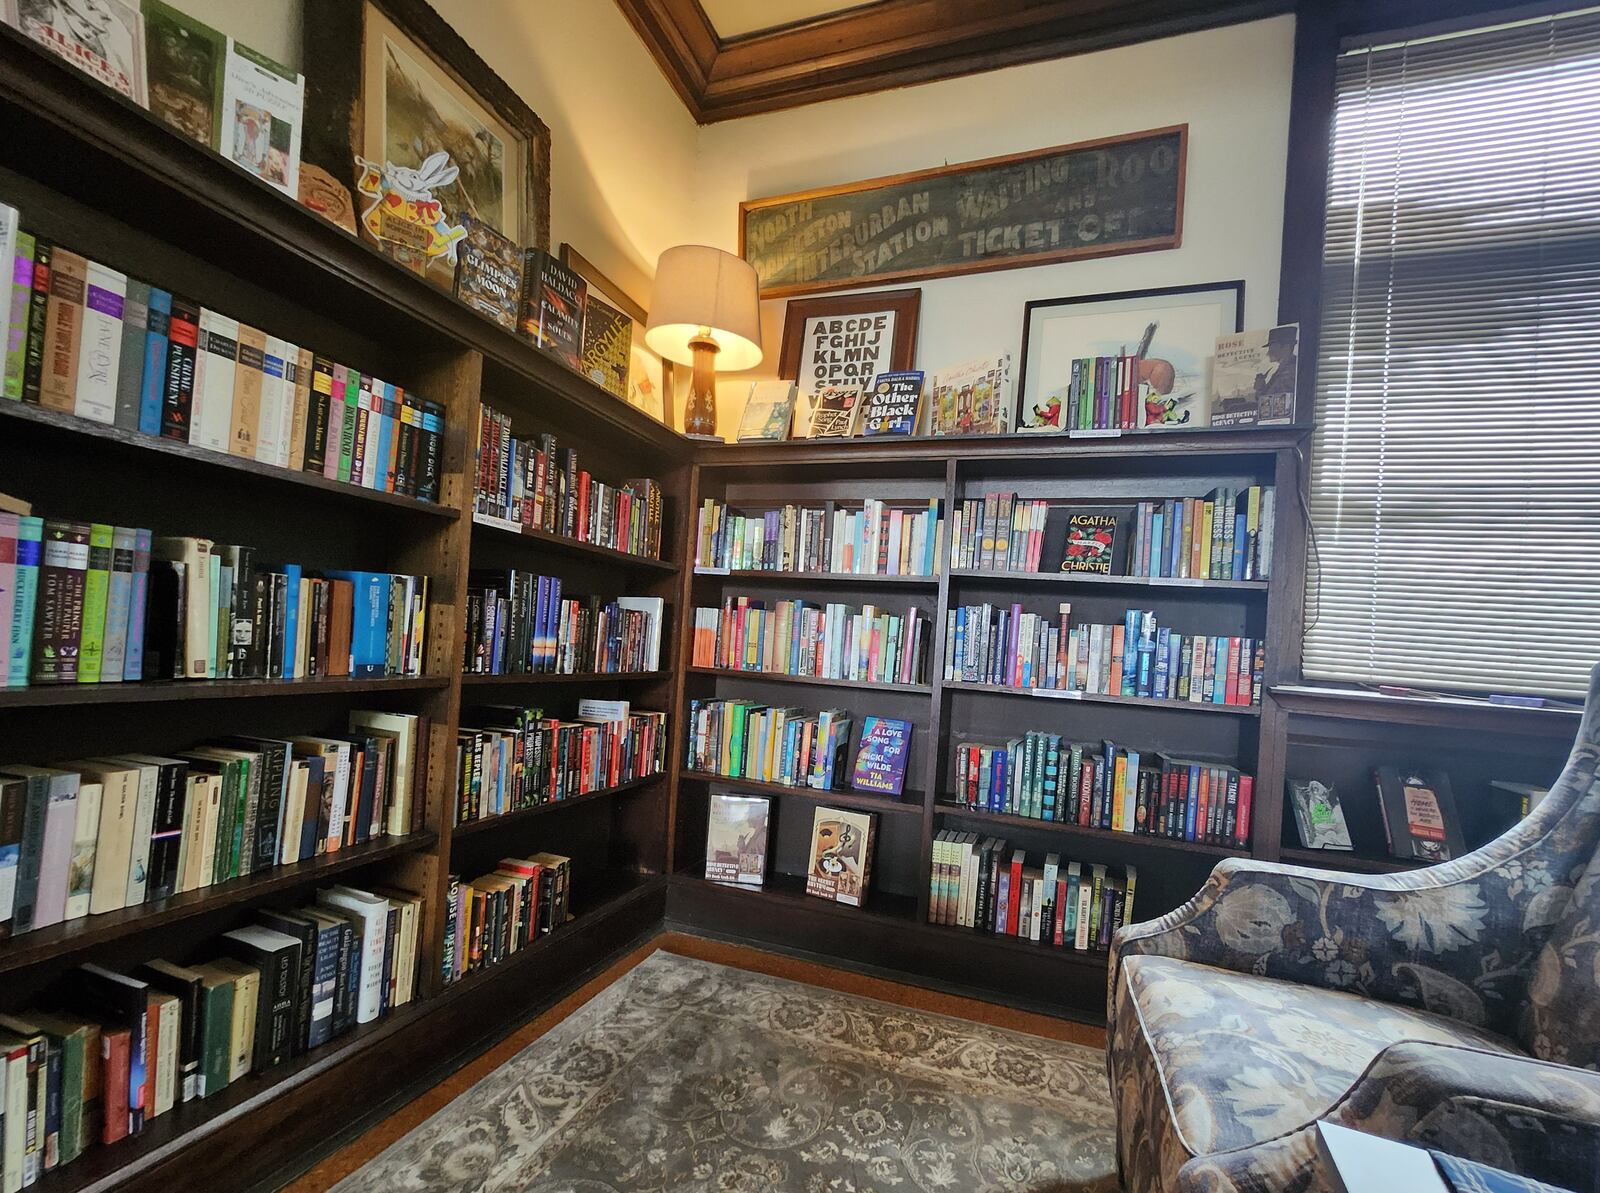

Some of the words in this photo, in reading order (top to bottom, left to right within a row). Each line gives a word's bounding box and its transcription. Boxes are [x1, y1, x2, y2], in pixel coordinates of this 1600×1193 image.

[851, 217, 949, 277] STATION
[957, 219, 1061, 257] TICKET
[466, 254, 517, 290] GLIMPSES
[550, 264, 577, 289] DAVID
[476, 275, 508, 298] MOON
[813, 315, 887, 336] ABCDE
[580, 315, 624, 374] ARGYLLE
[816, 331, 881, 349] FGHIJ
[1218, 340, 1244, 350] ROSE
[813, 346, 880, 364] KLMN
[168, 345, 182, 406] PUNISHMENT
[181, 358, 193, 392] CRIME
[814, 362, 874, 378] OPQR
[892, 383, 913, 392] The
[872, 393, 918, 405] Other
[344, 406, 355, 431] ROBIN
[870, 404, 914, 417] Black
[342, 431, 352, 456] HOOD
[428, 434, 436, 456] MOBY
[502, 427, 510, 451] DAVID
[426, 458, 435, 478] DICK
[499, 452, 509, 492] BALDACCI
[1070, 515, 1116, 525] AGATHA
[1213, 506, 1224, 538] HEIRESS
[1223, 507, 1235, 539] HEIRESS
[1062, 561, 1109, 573] CHRISTIE
[13, 568, 27, 623] HUCKLEBERRY
[47, 574, 57, 595] TOM
[43, 599, 54, 639] SAWYER
[61, 608, 70, 640] PAUPER
[72, 600, 81, 631] PRINCE
[12, 625, 23, 644] FINN
[475, 734, 483, 752] LARS
[867, 736, 889, 744] SONG
[882, 729, 902, 737] LOVE
[884, 746, 900, 754] FOR
[473, 755, 482, 781] KEPLER
[867, 761, 892, 772] WILDE
[870, 772, 882, 780] TIA
[270, 749, 284, 810] KIPLING
[856, 777, 893, 790] WILLIAMS
[1071, 776, 1079, 799] BODIES
[1228, 783, 1236, 804] TEACHER
[1410, 799, 1434, 807] HOME
[449, 881, 459, 920] LOUISE
[445, 934, 455, 968] PENNY
[280, 956, 289, 969] LEO
[278, 971, 288, 998] TOLSTOY
